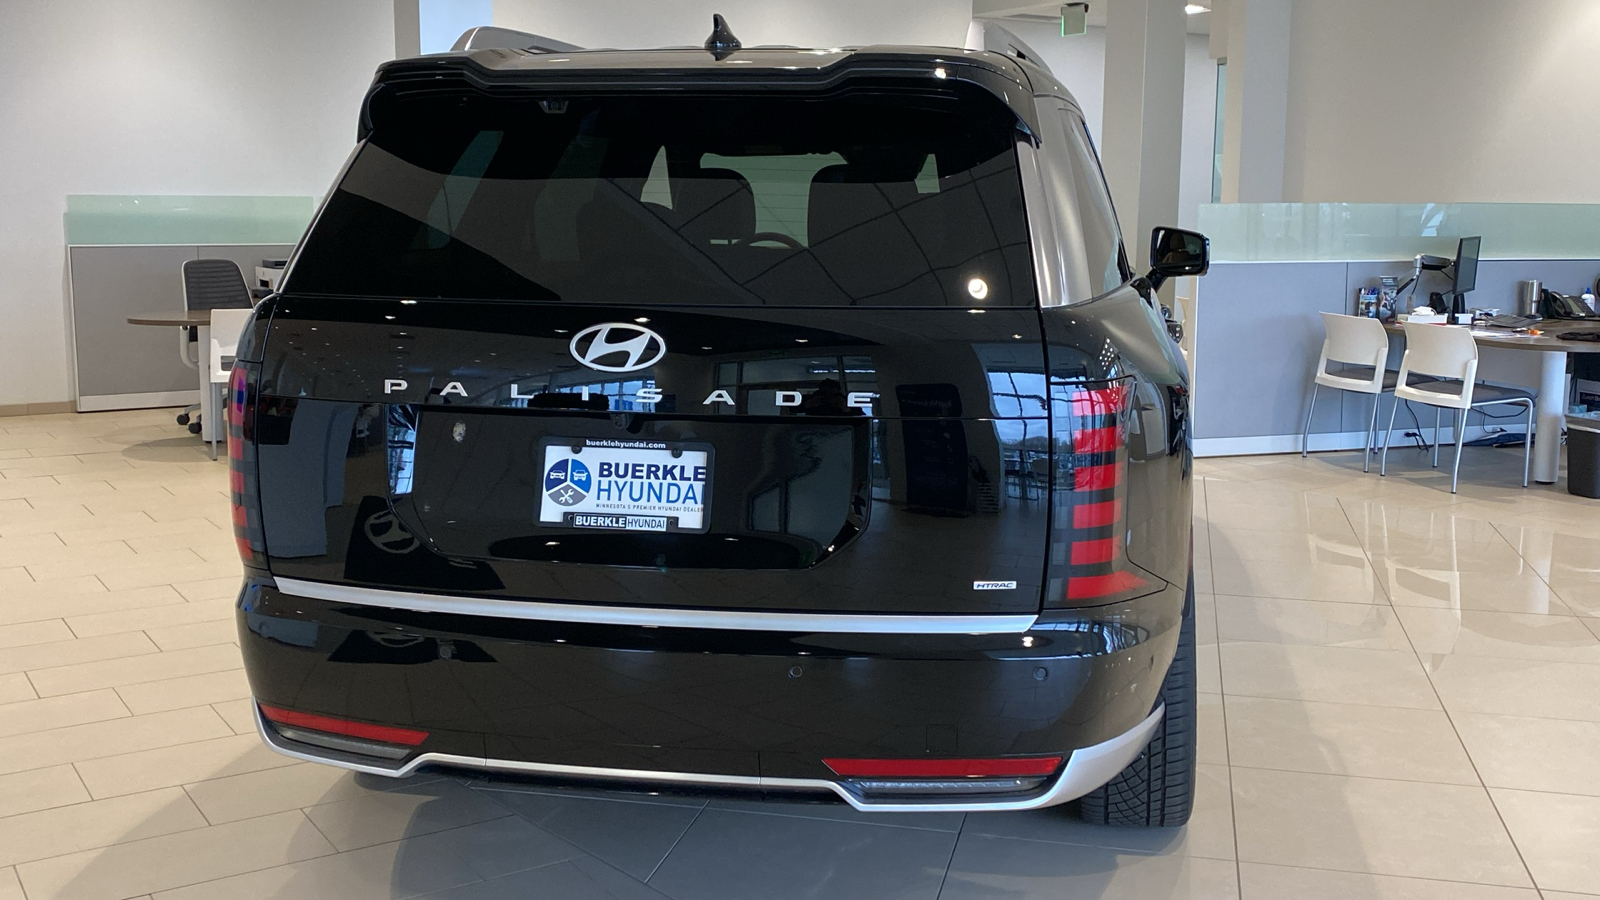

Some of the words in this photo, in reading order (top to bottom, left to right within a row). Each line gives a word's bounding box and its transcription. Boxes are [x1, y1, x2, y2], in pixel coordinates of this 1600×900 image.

[384, 379, 876, 408] PALISADE
[586, 439, 666, 449] buerklehyundai.com
[598, 462, 706, 482] BUERKLE
[575, 514, 626, 528] BUERKLE
[627, 517, 665, 529] HYUNDAI
